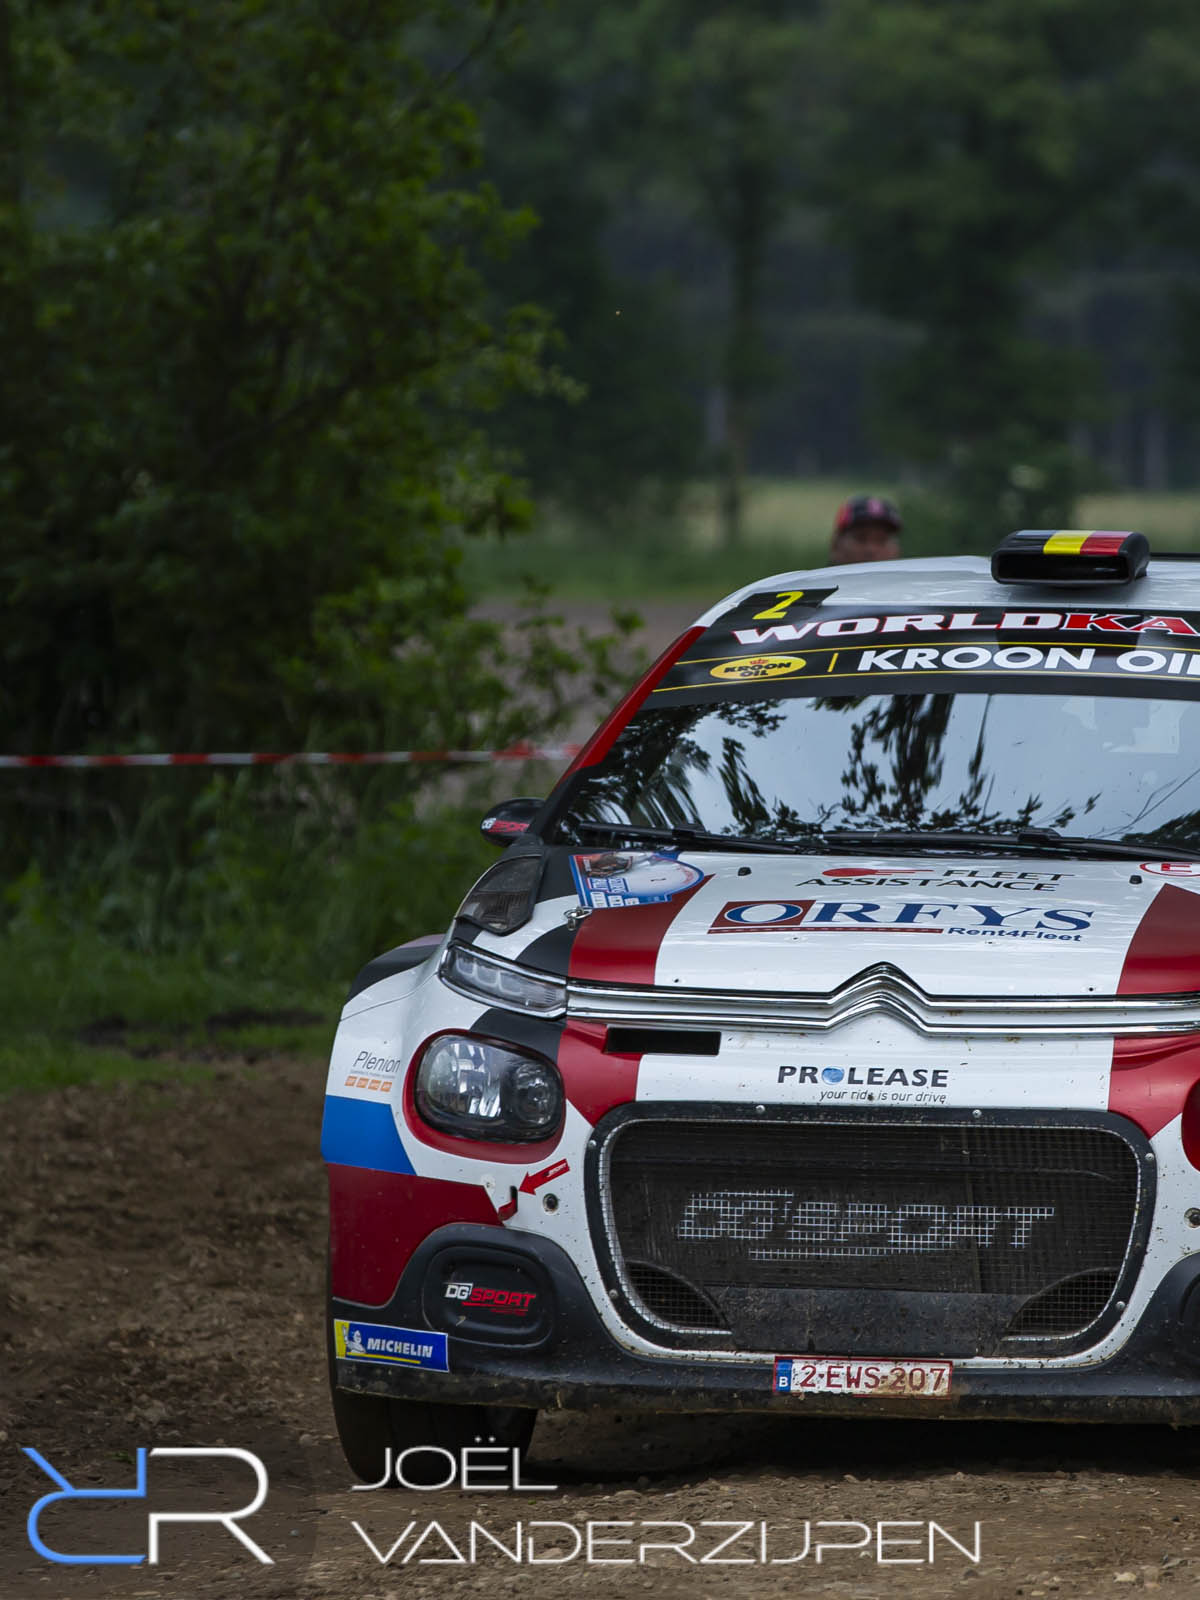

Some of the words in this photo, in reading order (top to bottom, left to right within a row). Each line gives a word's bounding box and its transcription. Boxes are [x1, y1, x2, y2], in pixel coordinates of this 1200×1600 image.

[752, 590, 804, 620] 2
[857, 646, 1096, 672] KROON
[723, 661, 793, 674] KROON
[738, 667, 770, 678] OIL
[942, 869, 1075, 882] FLEET
[796, 877, 1061, 892] ASSISTANCE
[723, 901, 1096, 932] ORFYS
[948, 927, 1083, 942] Rent4Fleet
[352, 1050, 401, 1073] Plenion
[819, 1090, 848, 1102] your
[878, 1090, 888, 1101] is
[891, 1093, 912, 1102] our
[915, 1092, 947, 1104] drive
[366, 1337, 434, 1358] MICHELIN
[778, 1376, 789, 1388] B
